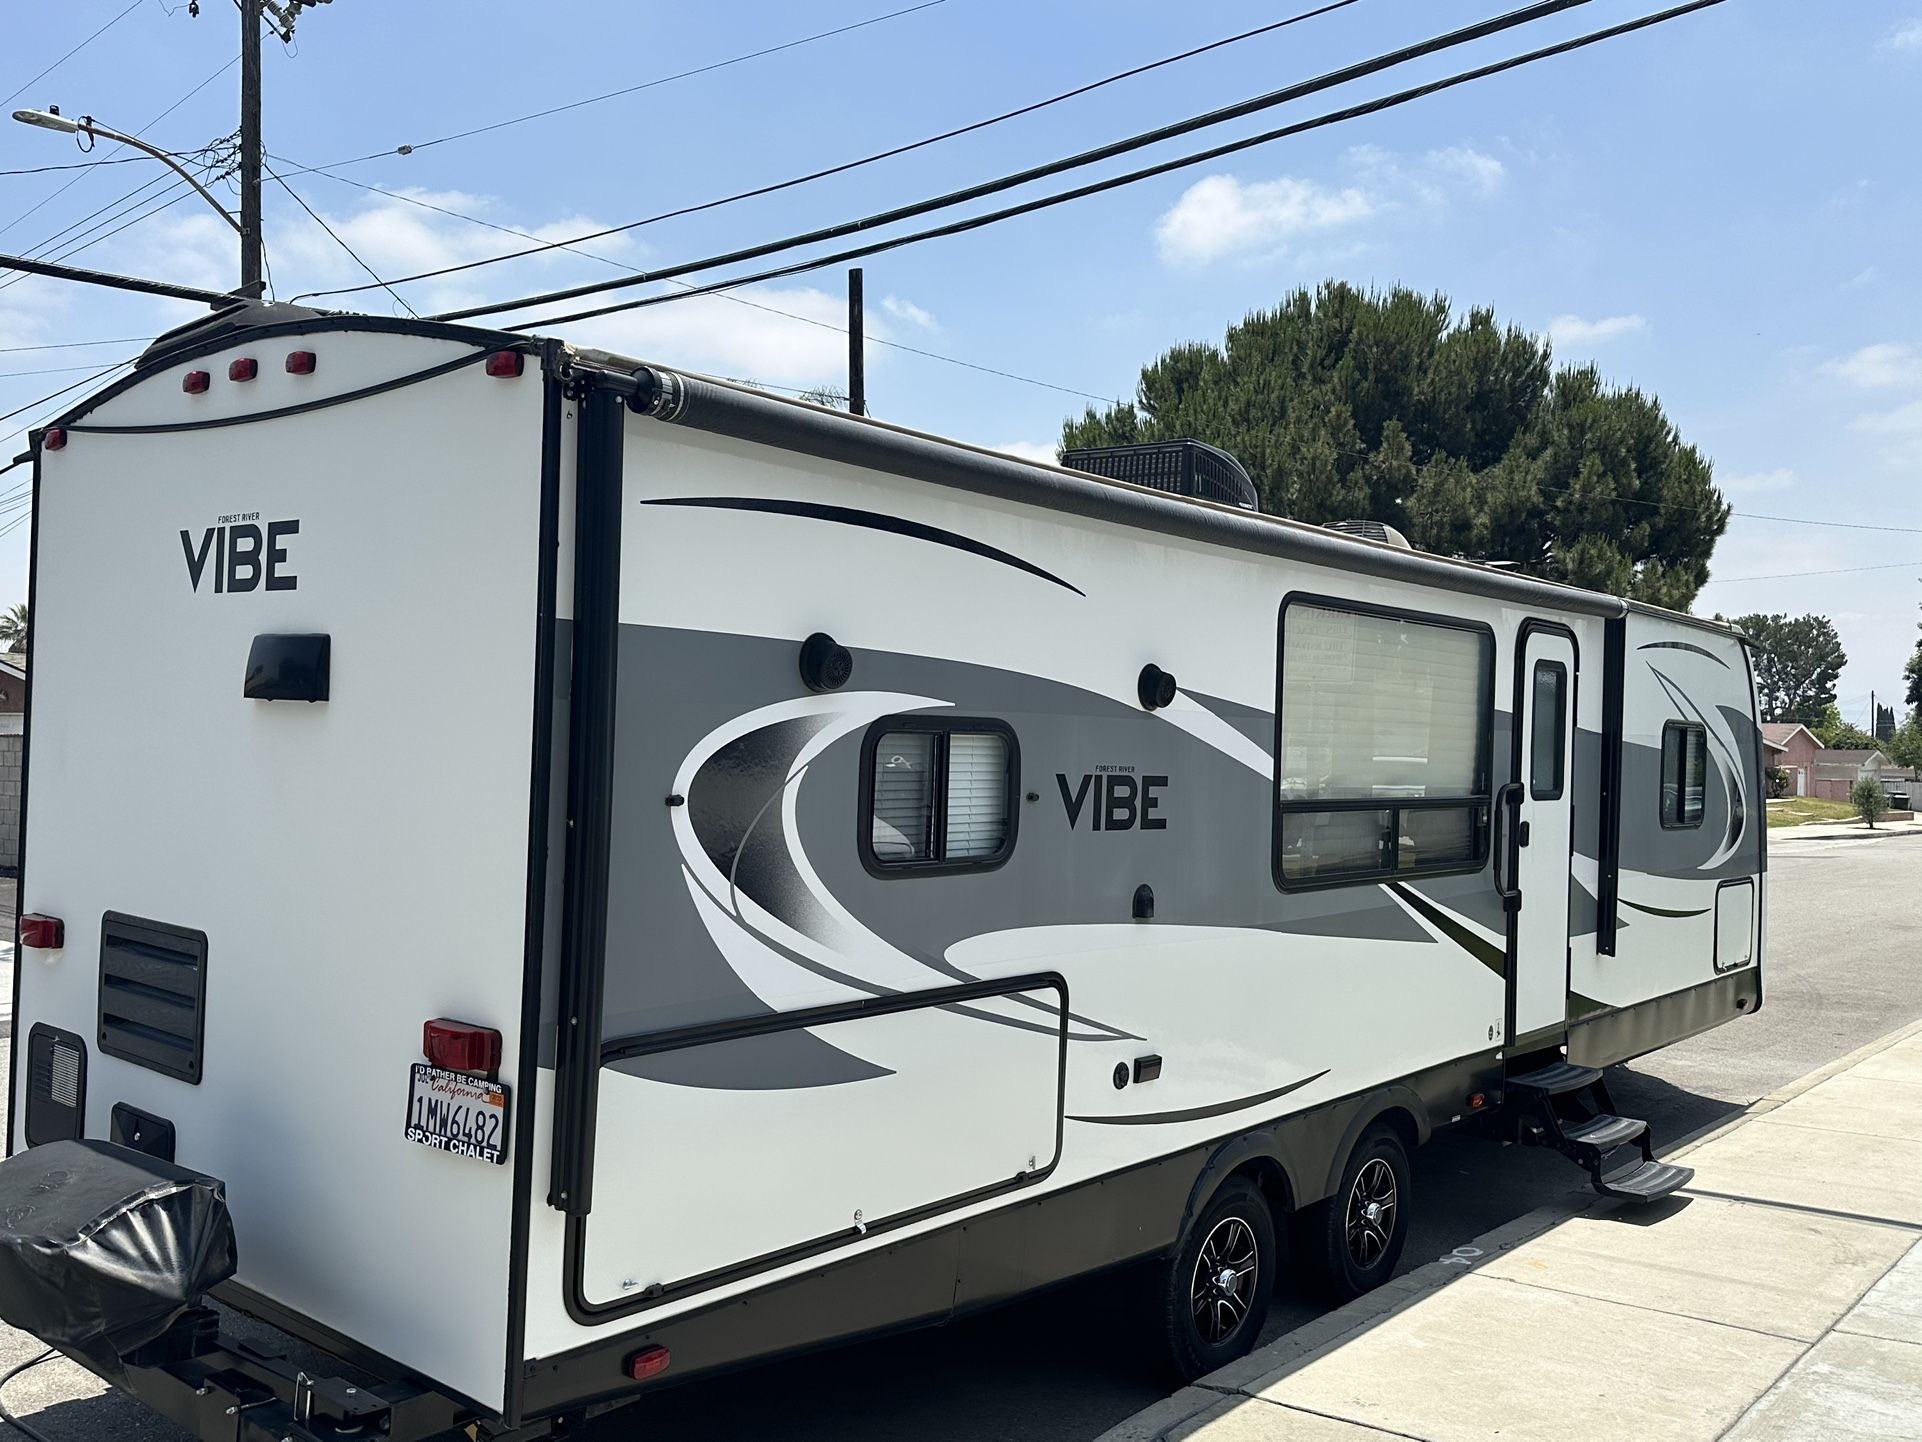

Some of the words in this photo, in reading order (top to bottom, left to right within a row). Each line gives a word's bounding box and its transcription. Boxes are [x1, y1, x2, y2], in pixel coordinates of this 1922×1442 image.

[218, 513, 240, 524] FOREST
[241, 512, 260, 522] RIVER
[180, 519, 300, 594] VIBE
[1095, 764, 1117, 773] FOREST
[1055, 773, 1168, 832] VIBE
[415, 1065, 425, 1074] I'D
[426, 1067, 455, 1081] RATHER
[456, 1073, 467, 1084] BE
[468, 1077, 502, 1093] CAMPING
[431, 1078, 484, 1100] California
[413, 1096, 500, 1150] 1MW6482
[407, 1128, 448, 1150] SPORT
[450, 1140, 500, 1164] CHALET
